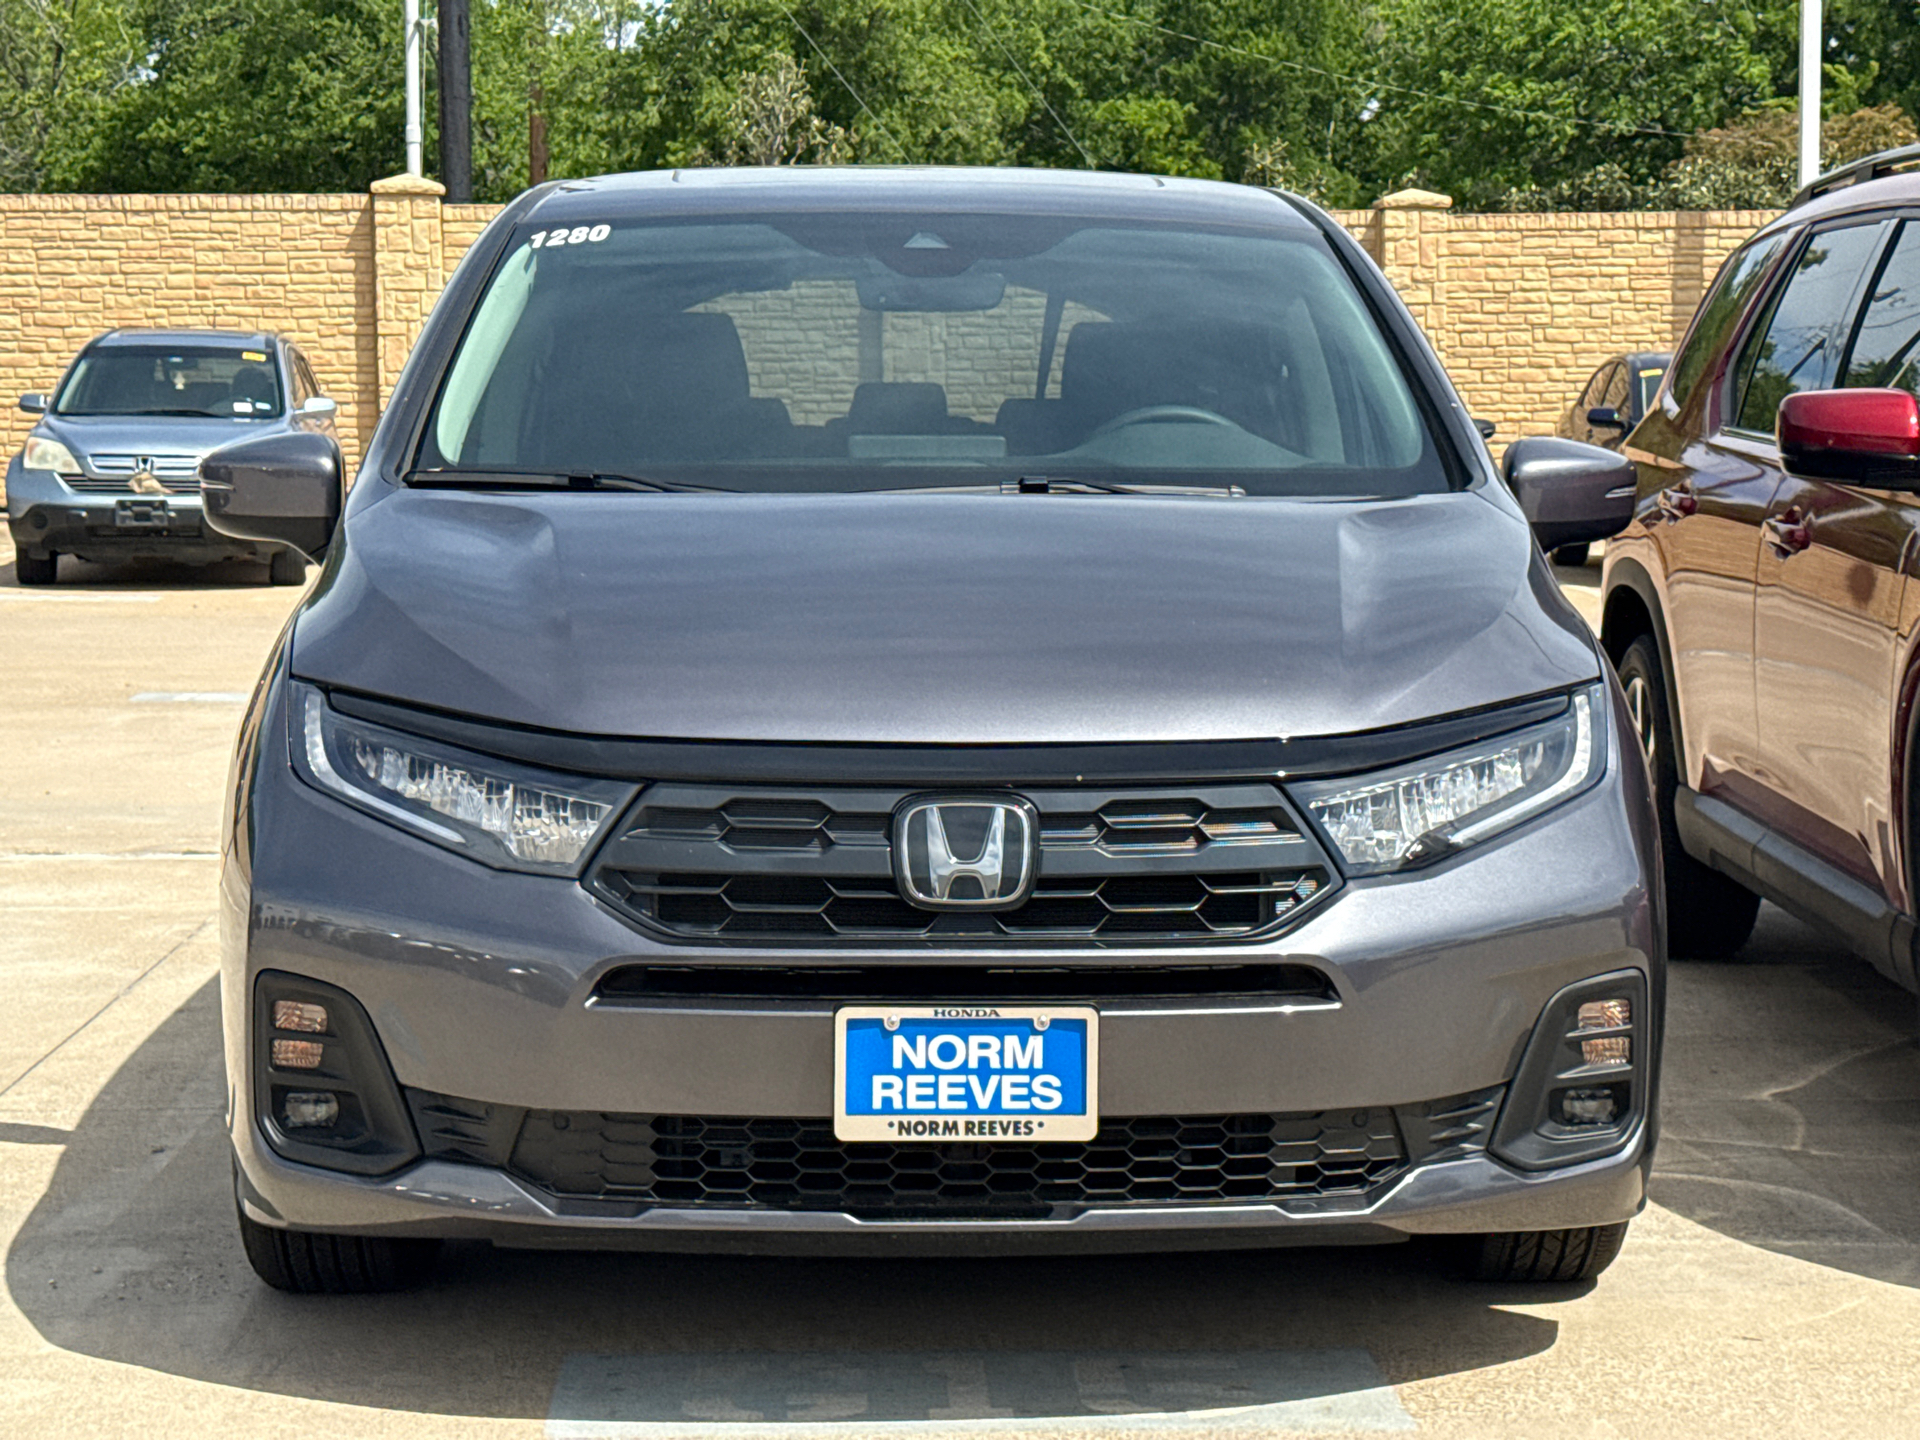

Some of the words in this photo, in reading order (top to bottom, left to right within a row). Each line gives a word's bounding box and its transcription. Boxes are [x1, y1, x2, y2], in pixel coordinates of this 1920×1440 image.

[530, 224, 611, 249] 1280
[933, 1009, 1000, 1018] HONDA
[892, 1034, 1043, 1070] NORM
[872, 1074, 1063, 1110] REEVES
[897, 1121, 960, 1136] NORM
[964, 1120, 1034, 1136] REEVES
